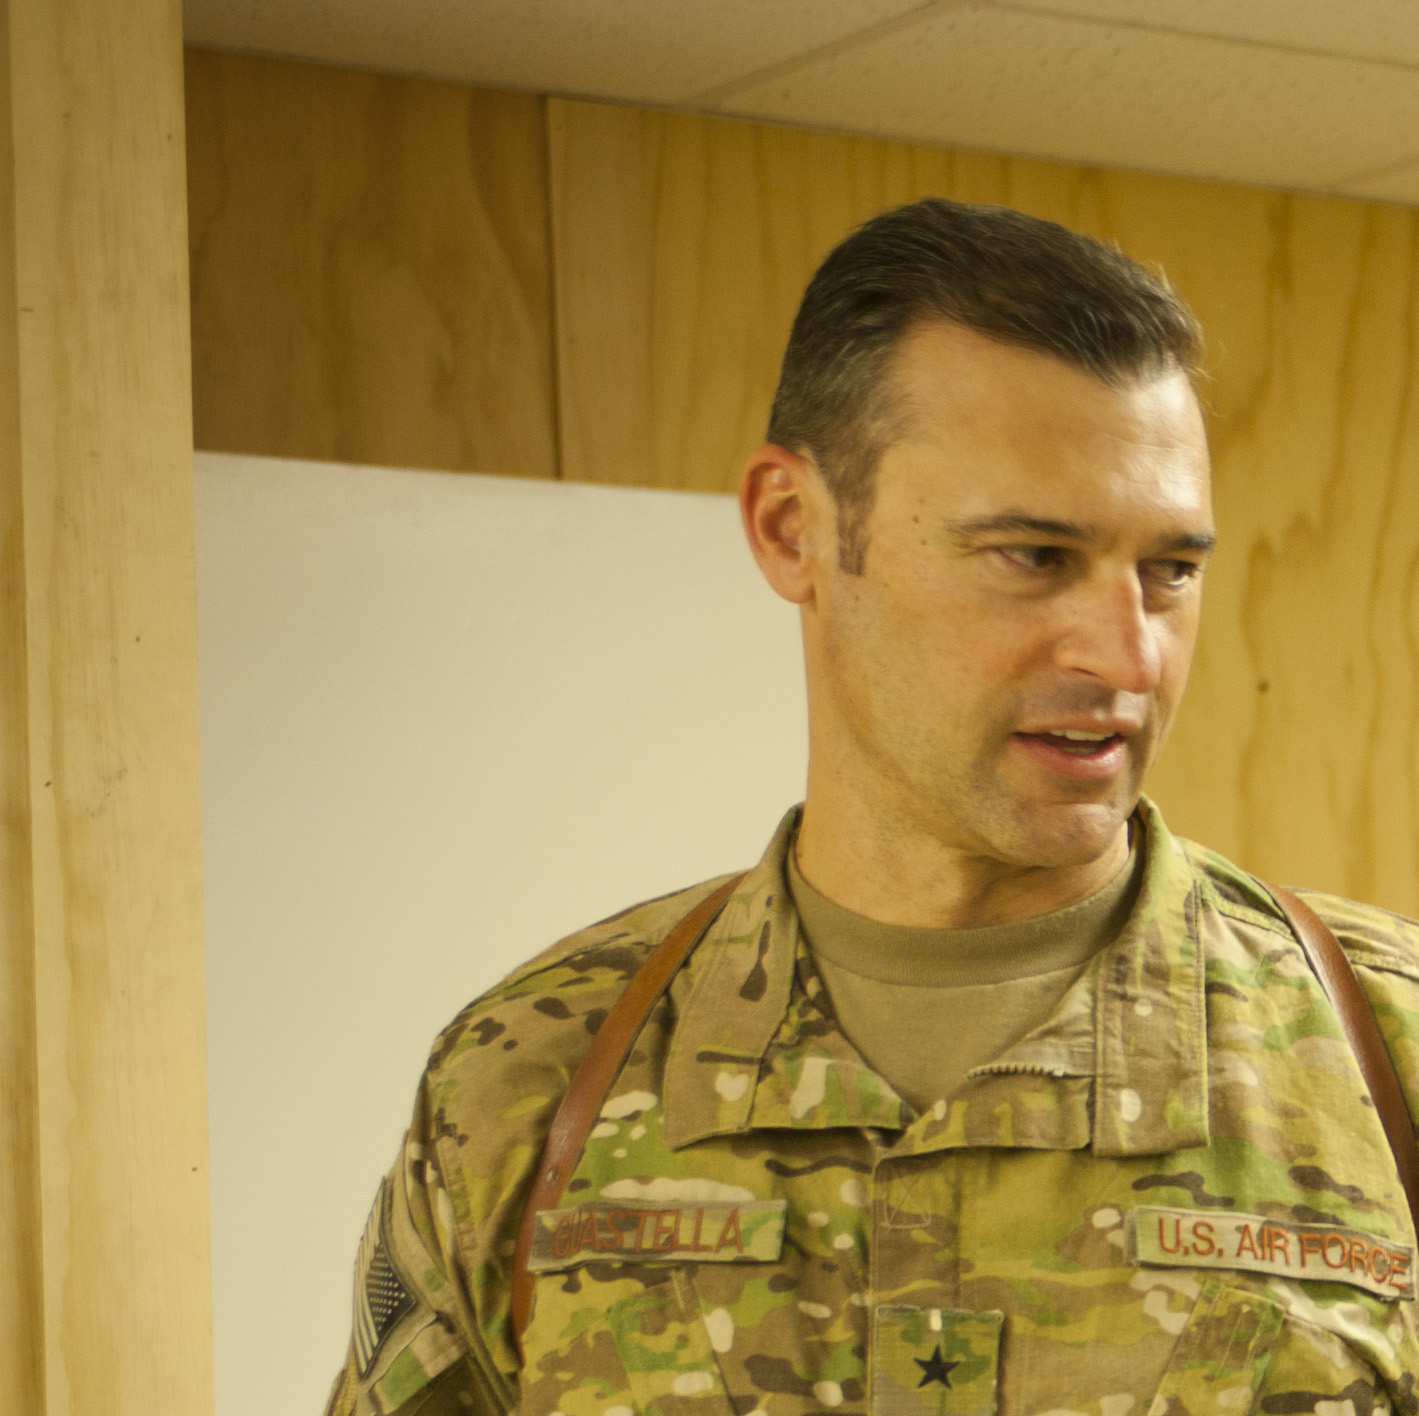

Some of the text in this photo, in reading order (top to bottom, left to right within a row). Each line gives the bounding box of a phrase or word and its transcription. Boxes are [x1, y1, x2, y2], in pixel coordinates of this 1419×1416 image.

[1157, 1216, 1411, 1292] U.S. AIR FORCE
